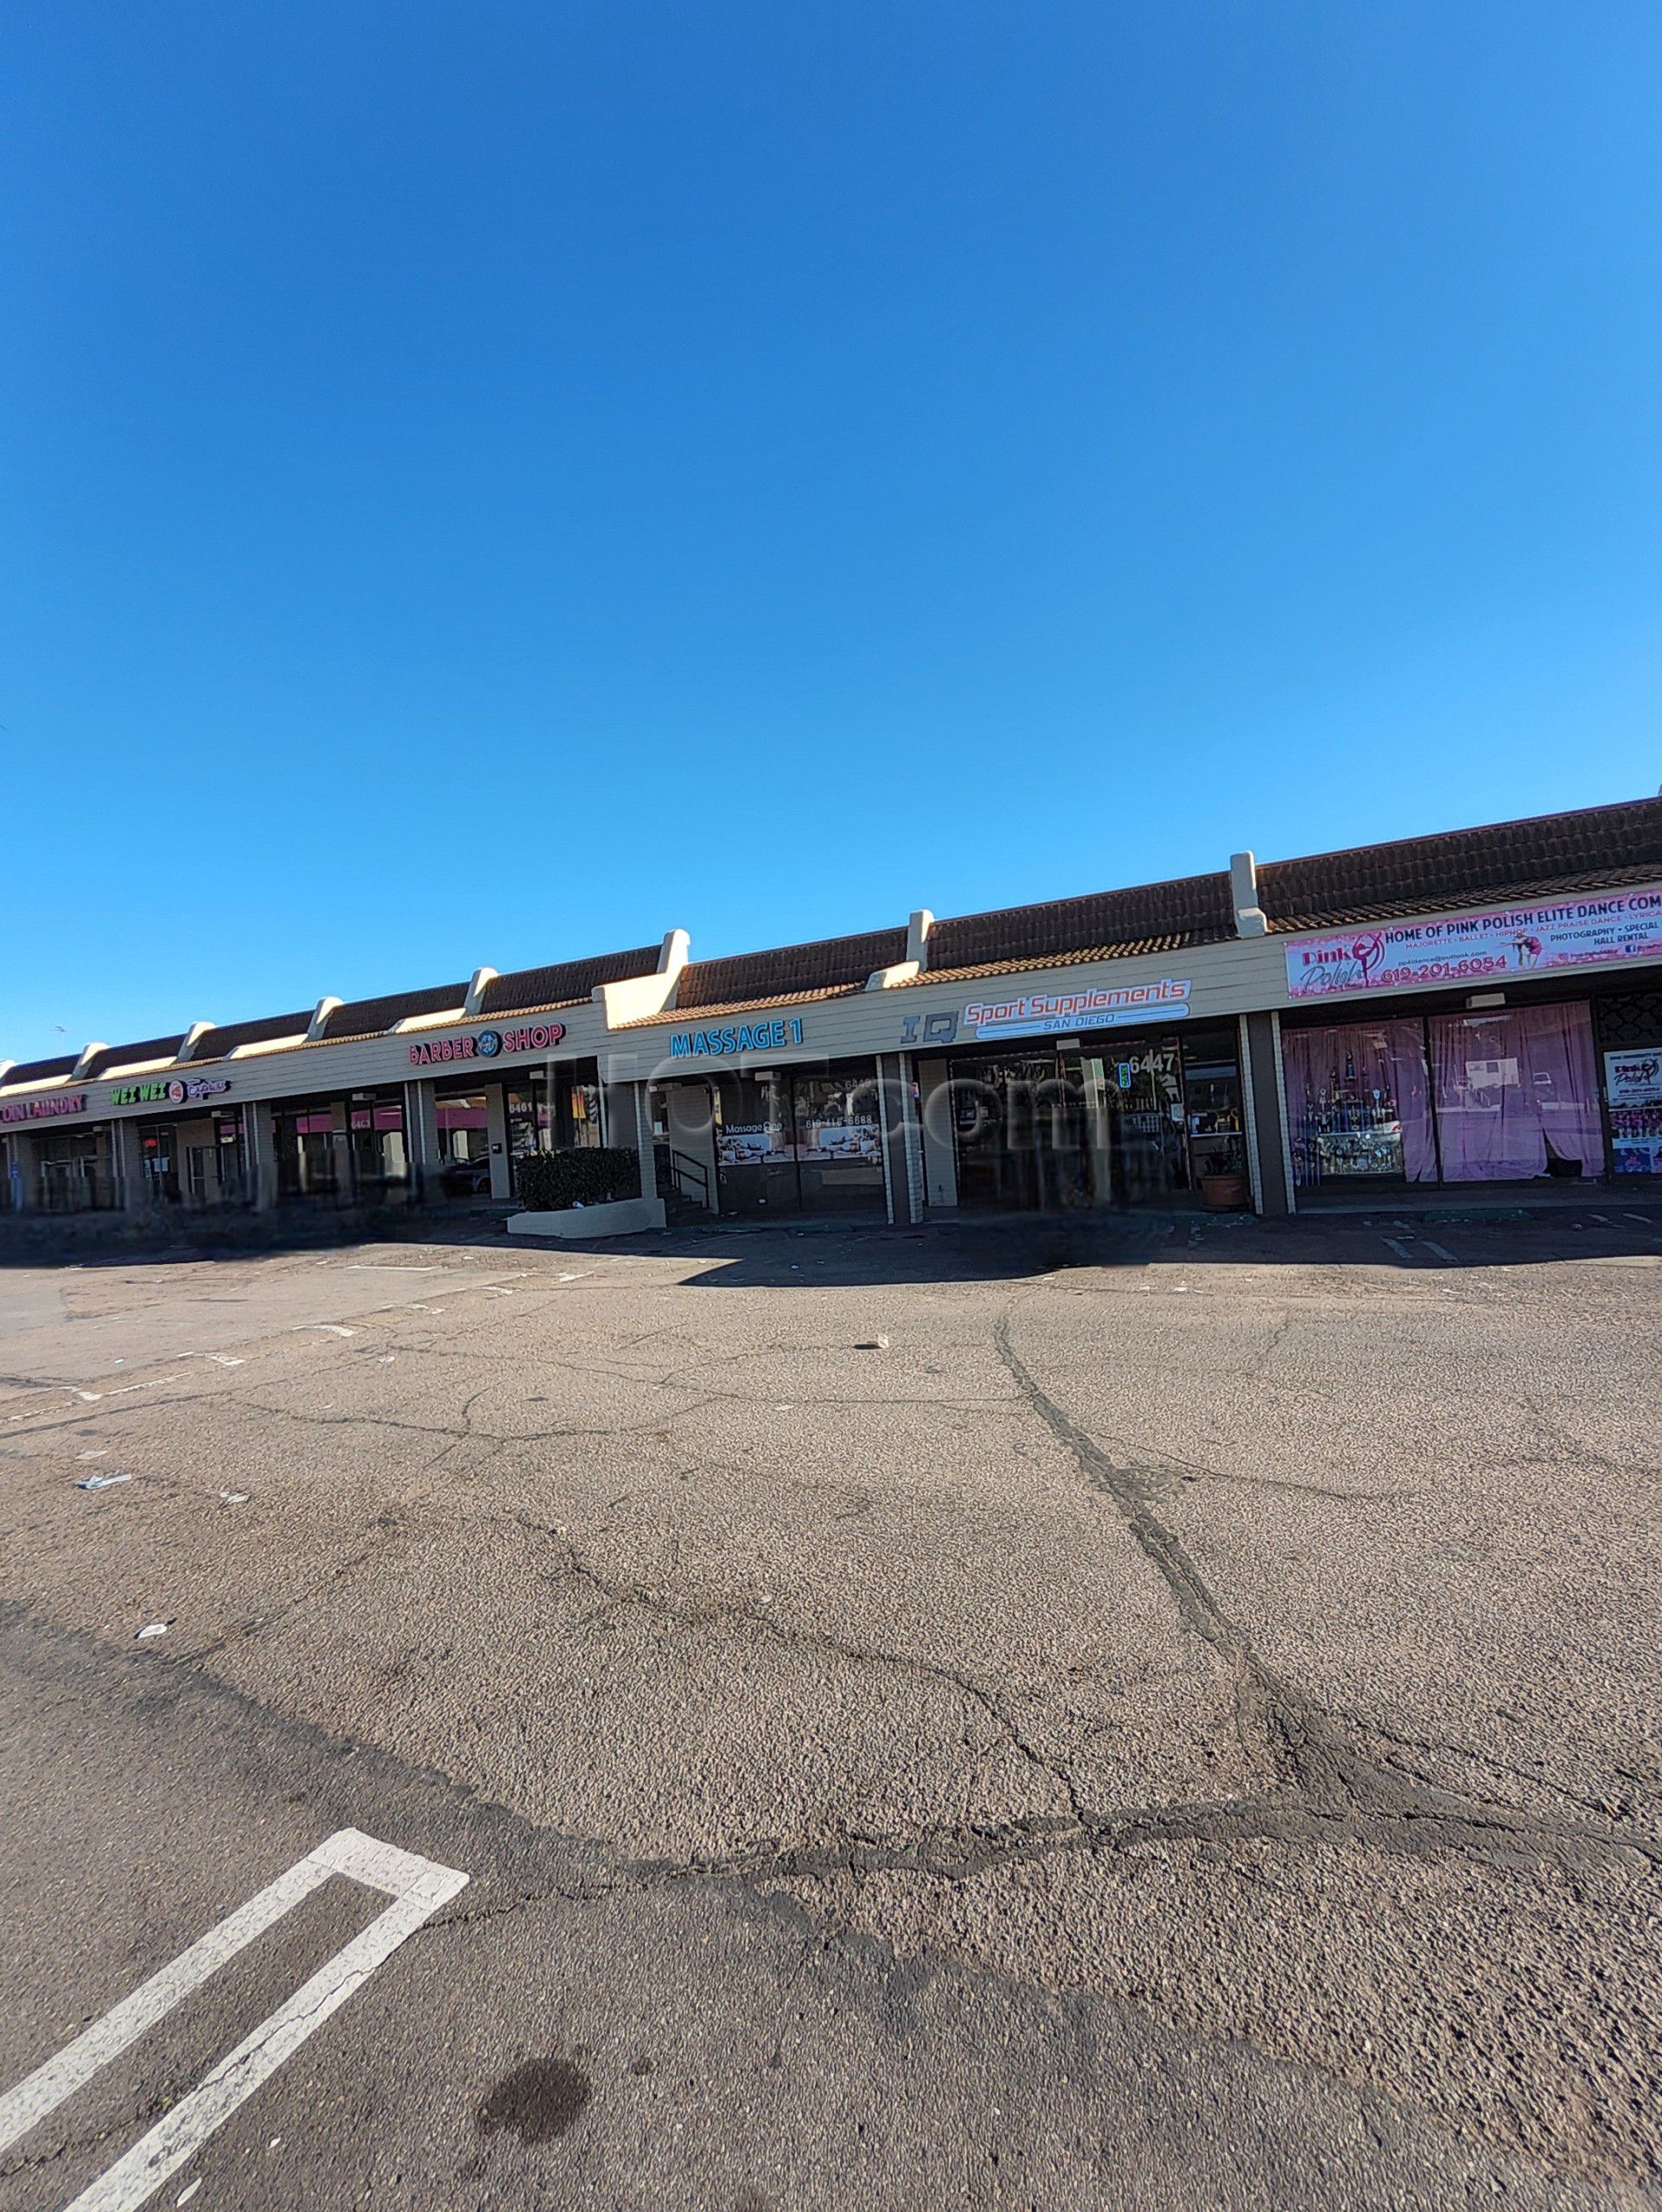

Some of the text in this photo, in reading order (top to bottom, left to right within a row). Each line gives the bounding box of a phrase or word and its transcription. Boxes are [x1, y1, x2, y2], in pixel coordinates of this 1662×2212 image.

[1385, 895, 1662, 944] HOME OF PINK POLISH ELITE DANCE COM
[1405, 938, 1453, 950] MAJORETTE
[1459, 933, 1488, 943] BALLET
[1558, 919, 1589, 929] PRAISE
[1591, 915, 1621, 925] DANCE
[1551, 921, 1659, 942] PHOTOGRAPHY SPECIAL
[1594, 931, 1649, 945] HALL RENTAL
[1302, 947, 1353, 966] Pink
[1381, 955, 1506, 983] 619-201-6054
[1300, 961, 1363, 991] Polish
[966, 981, 1186, 1026] Sport Supplements
[900, 1010, 958, 1045] IQ
[1043, 1014, 1115, 1030] SAN DIEGO
[408, 1037, 474, 1065] BARBER
[503, 1023, 564, 1052] SHOP
[670, 1017, 803, 1059] MASSAGE 1
[1129, 1052, 1175, 1074] 6447
[0, 1094, 83, 1123] OIN LAUNDRY
[111, 1088, 137, 1106] WEI
[140, 1083, 166, 1101] WEI
[725, 1123, 762, 1135] Massage
